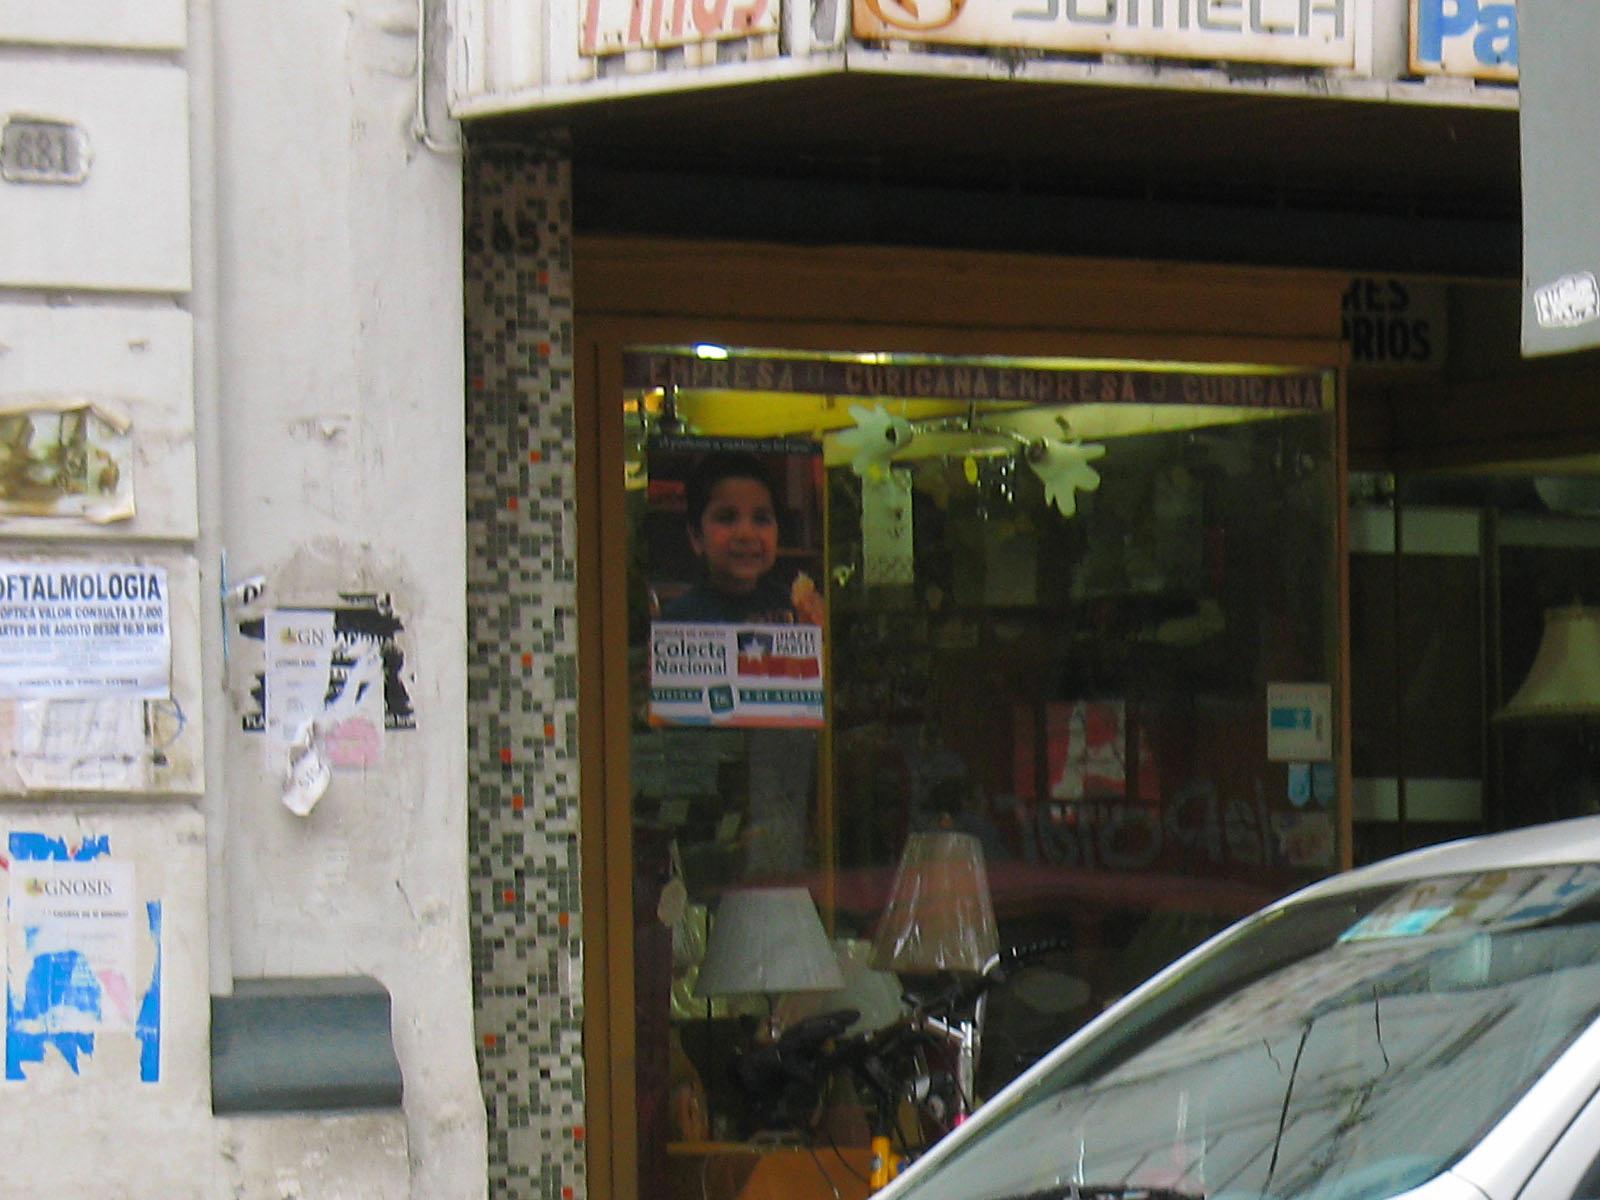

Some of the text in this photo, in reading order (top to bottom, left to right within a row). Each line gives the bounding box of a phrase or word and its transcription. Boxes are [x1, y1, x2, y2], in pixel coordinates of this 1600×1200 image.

[653, 639, 727, 658] Colecta
[654, 658, 728, 676] Nacional
[44, 878, 114, 897] GNOSIS
